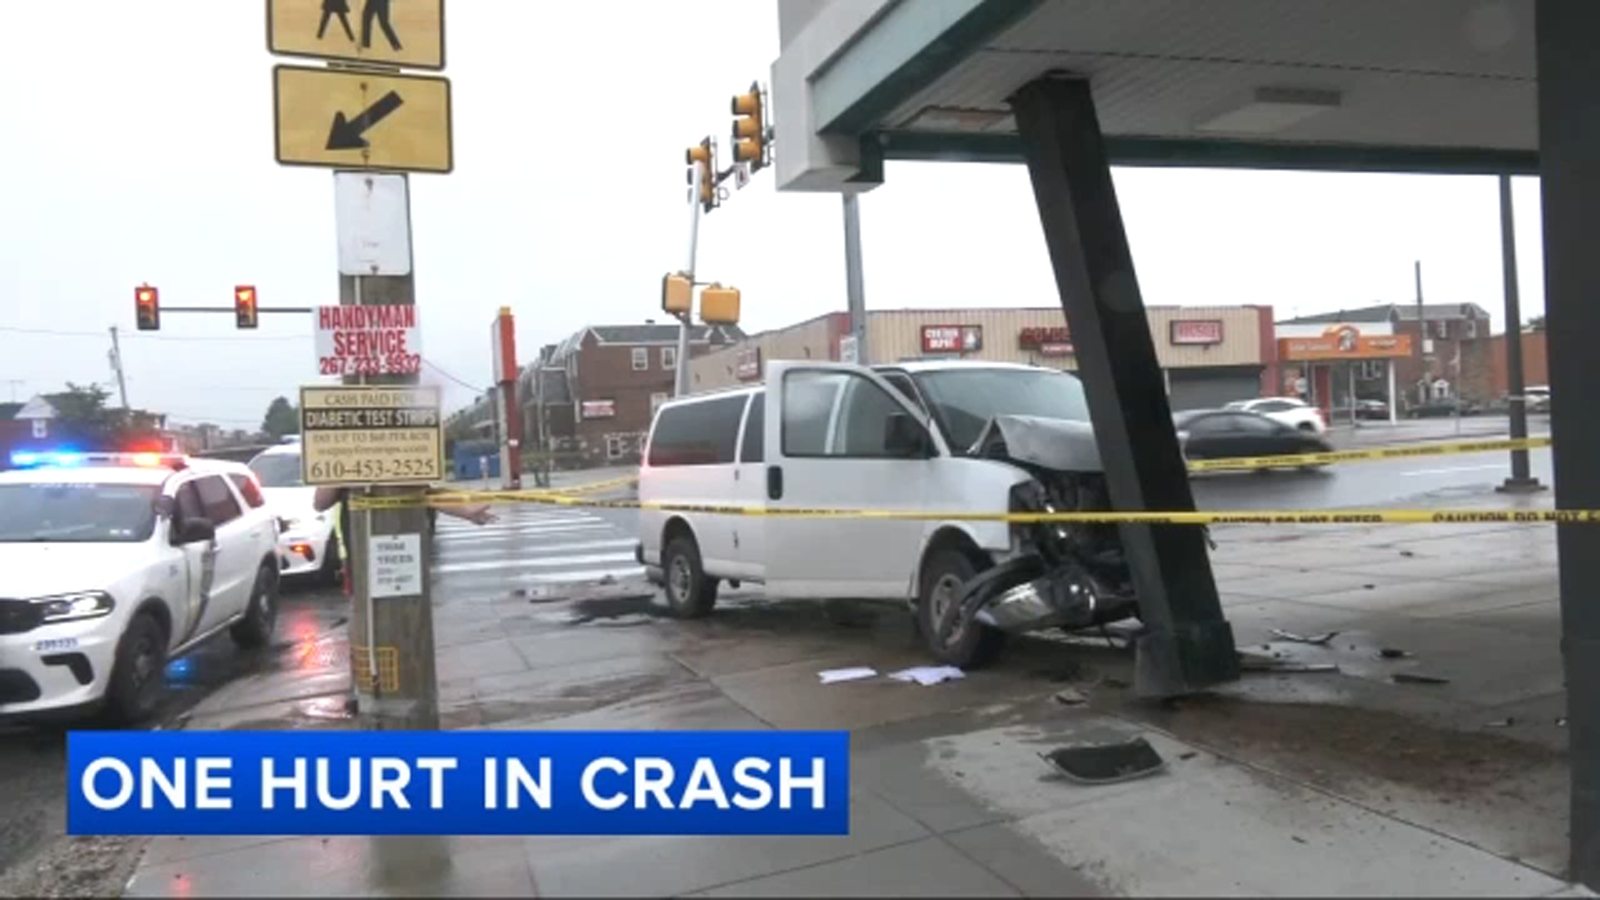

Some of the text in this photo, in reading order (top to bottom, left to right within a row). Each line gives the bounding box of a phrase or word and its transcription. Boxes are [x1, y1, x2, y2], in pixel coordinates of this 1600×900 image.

[319, 306, 415, 329] HANDYMAN
[333, 331, 406, 356] SERVICE
[325, 394, 358, 406] CASH
[360, 393, 391, 405] PAID
[306, 409, 436, 428] DIABETIC TEST STRIPS
[311, 459, 434, 479] 610-453-2525
[1431, 511, 1508, 523] CAUTION
[1514, 511, 1535, 522] DO
[1544, 511, 1580, 521] NOT
